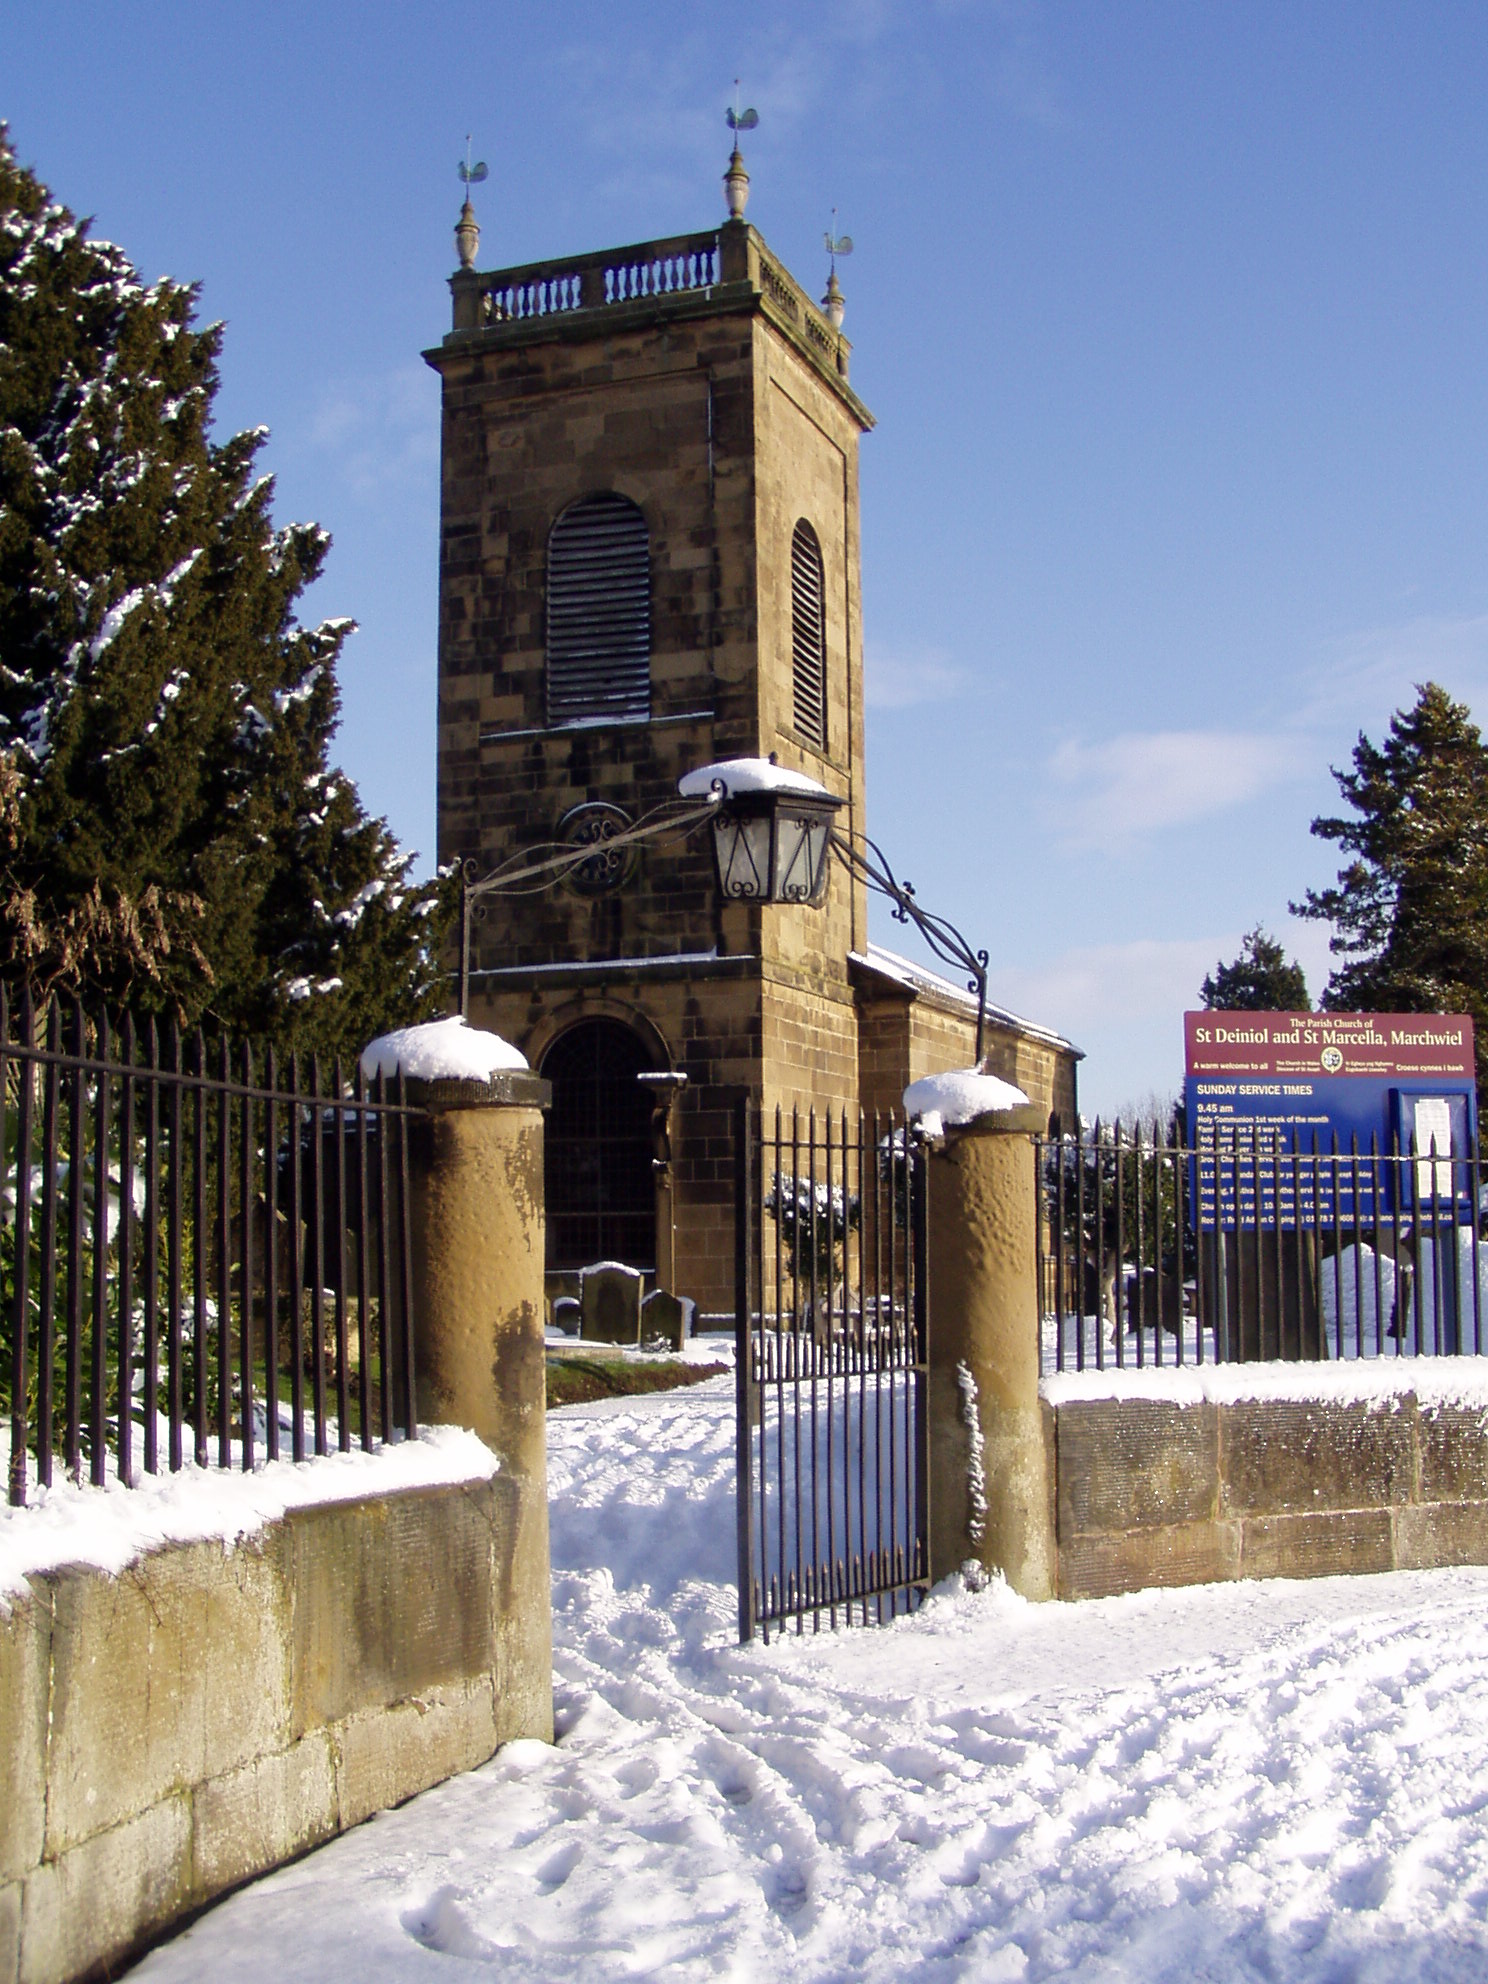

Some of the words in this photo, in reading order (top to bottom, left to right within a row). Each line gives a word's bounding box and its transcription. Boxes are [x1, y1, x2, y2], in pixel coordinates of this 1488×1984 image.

[1290, 1018, 1306, 1028] The
[1307, 1018, 1333, 1028] Parish
[1334, 1019, 1363, 1029] Church
[1364, 1019, 1374, 1029] of
[1196, 1027, 1212, 1043] St
[1215, 1028, 1269, 1043] Deiniol
[1273, 1028, 1300, 1044] and
[1304, 1029, 1319, 1044] St
[1322, 1029, 1388, 1047] Marcella,
[1391, 1030, 1463, 1046] Marchwiel
[1193, 1062, 1200, 1070] A
[1220, 1062, 1250, 1070] welcome
[1197, 1084, 1237, 1095] SUNDAY
[1239, 1085, 1281, 1095] SERVICE
[1283, 1085, 1313, 1095] TIMES
[1197, 1103, 1218, 1113] 9.45
[1219, 1104, 1234, 1113] am
[1197, 1116, 1213, 1124] Holy
[1215, 1116, 1254, 1124] Communion
